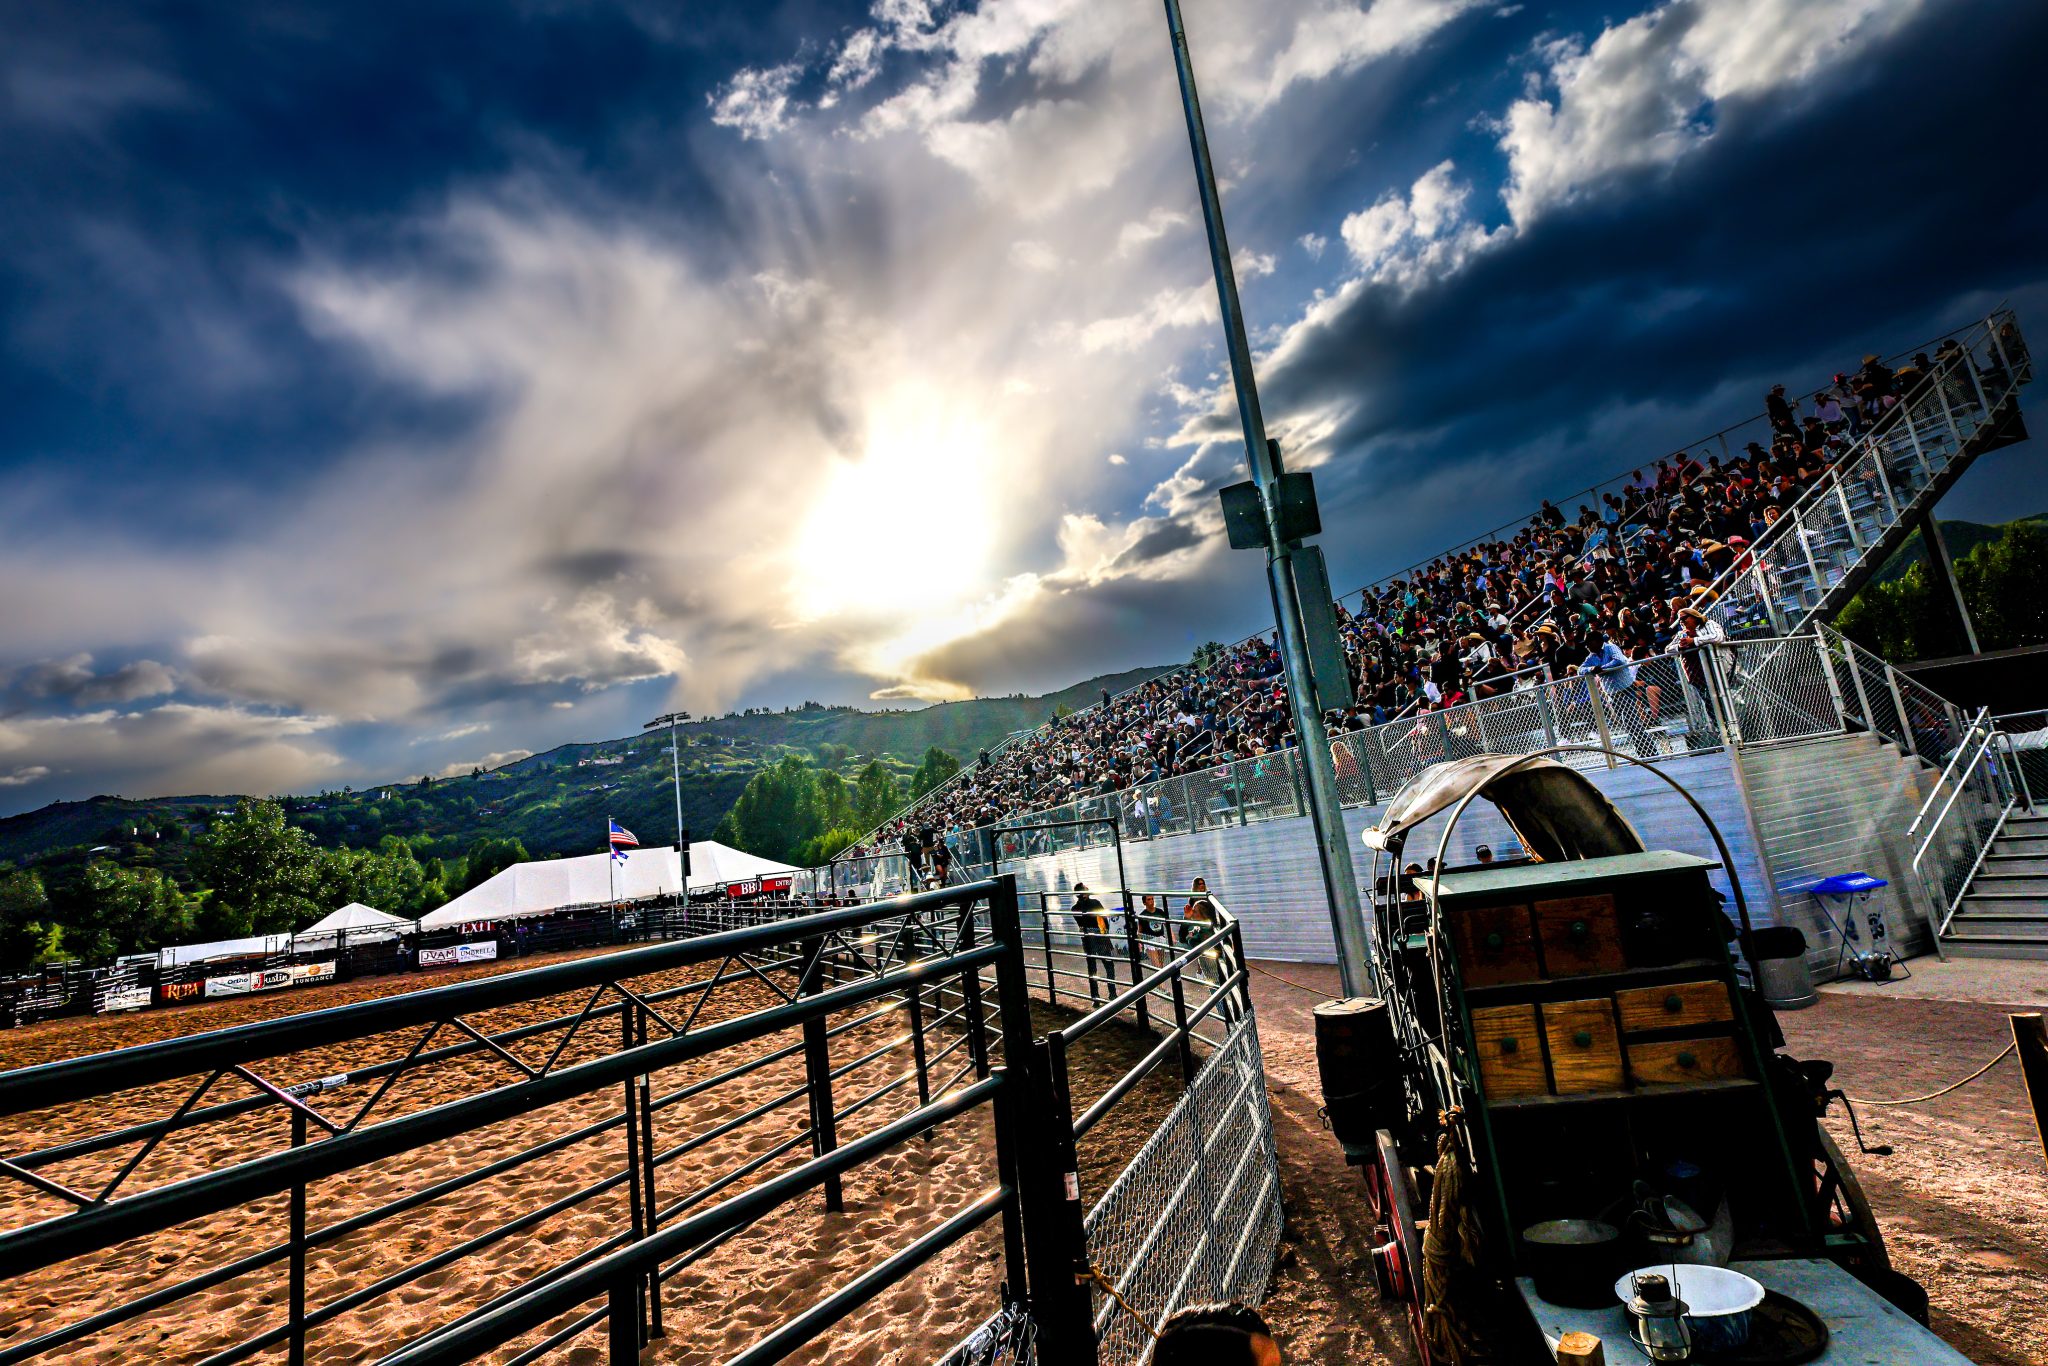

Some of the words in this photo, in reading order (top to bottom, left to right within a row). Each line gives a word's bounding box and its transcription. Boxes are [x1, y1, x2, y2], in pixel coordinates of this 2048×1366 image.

[461, 920, 492, 934] EXIT
[423, 950, 454, 960] JVAM
[460, 948, 496, 957] UMBRELLA
[227, 977, 249, 985] Ortho
[253, 972, 288, 989] Justin
[295, 974, 334, 984] SUNDANCE
